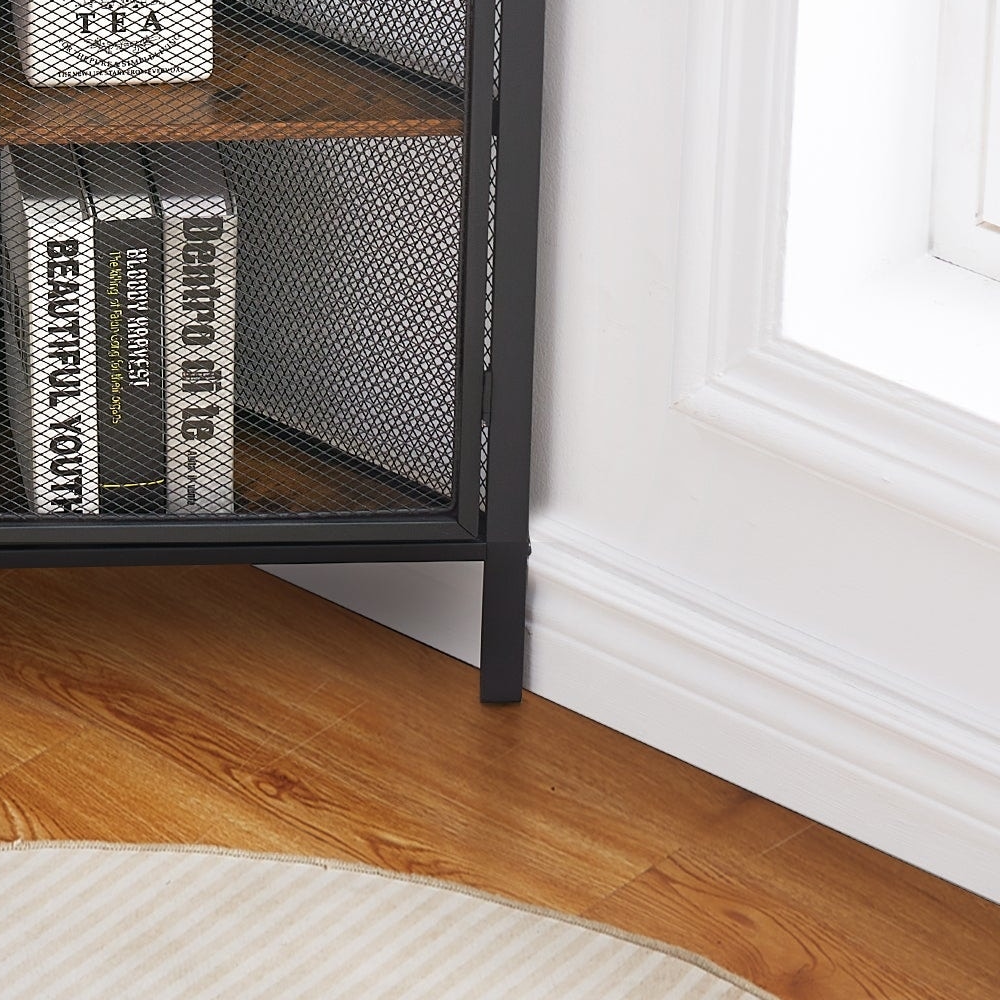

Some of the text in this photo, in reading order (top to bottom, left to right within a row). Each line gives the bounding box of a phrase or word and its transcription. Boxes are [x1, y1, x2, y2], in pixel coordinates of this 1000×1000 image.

[46, 239, 82, 408] BEAUTIFUL
[106, 251, 122, 425] The killing of Falun Gong for their organs
[126, 248, 149, 388] BLOODY HARVEST
[180, 216, 224, 441] Dentro di te
